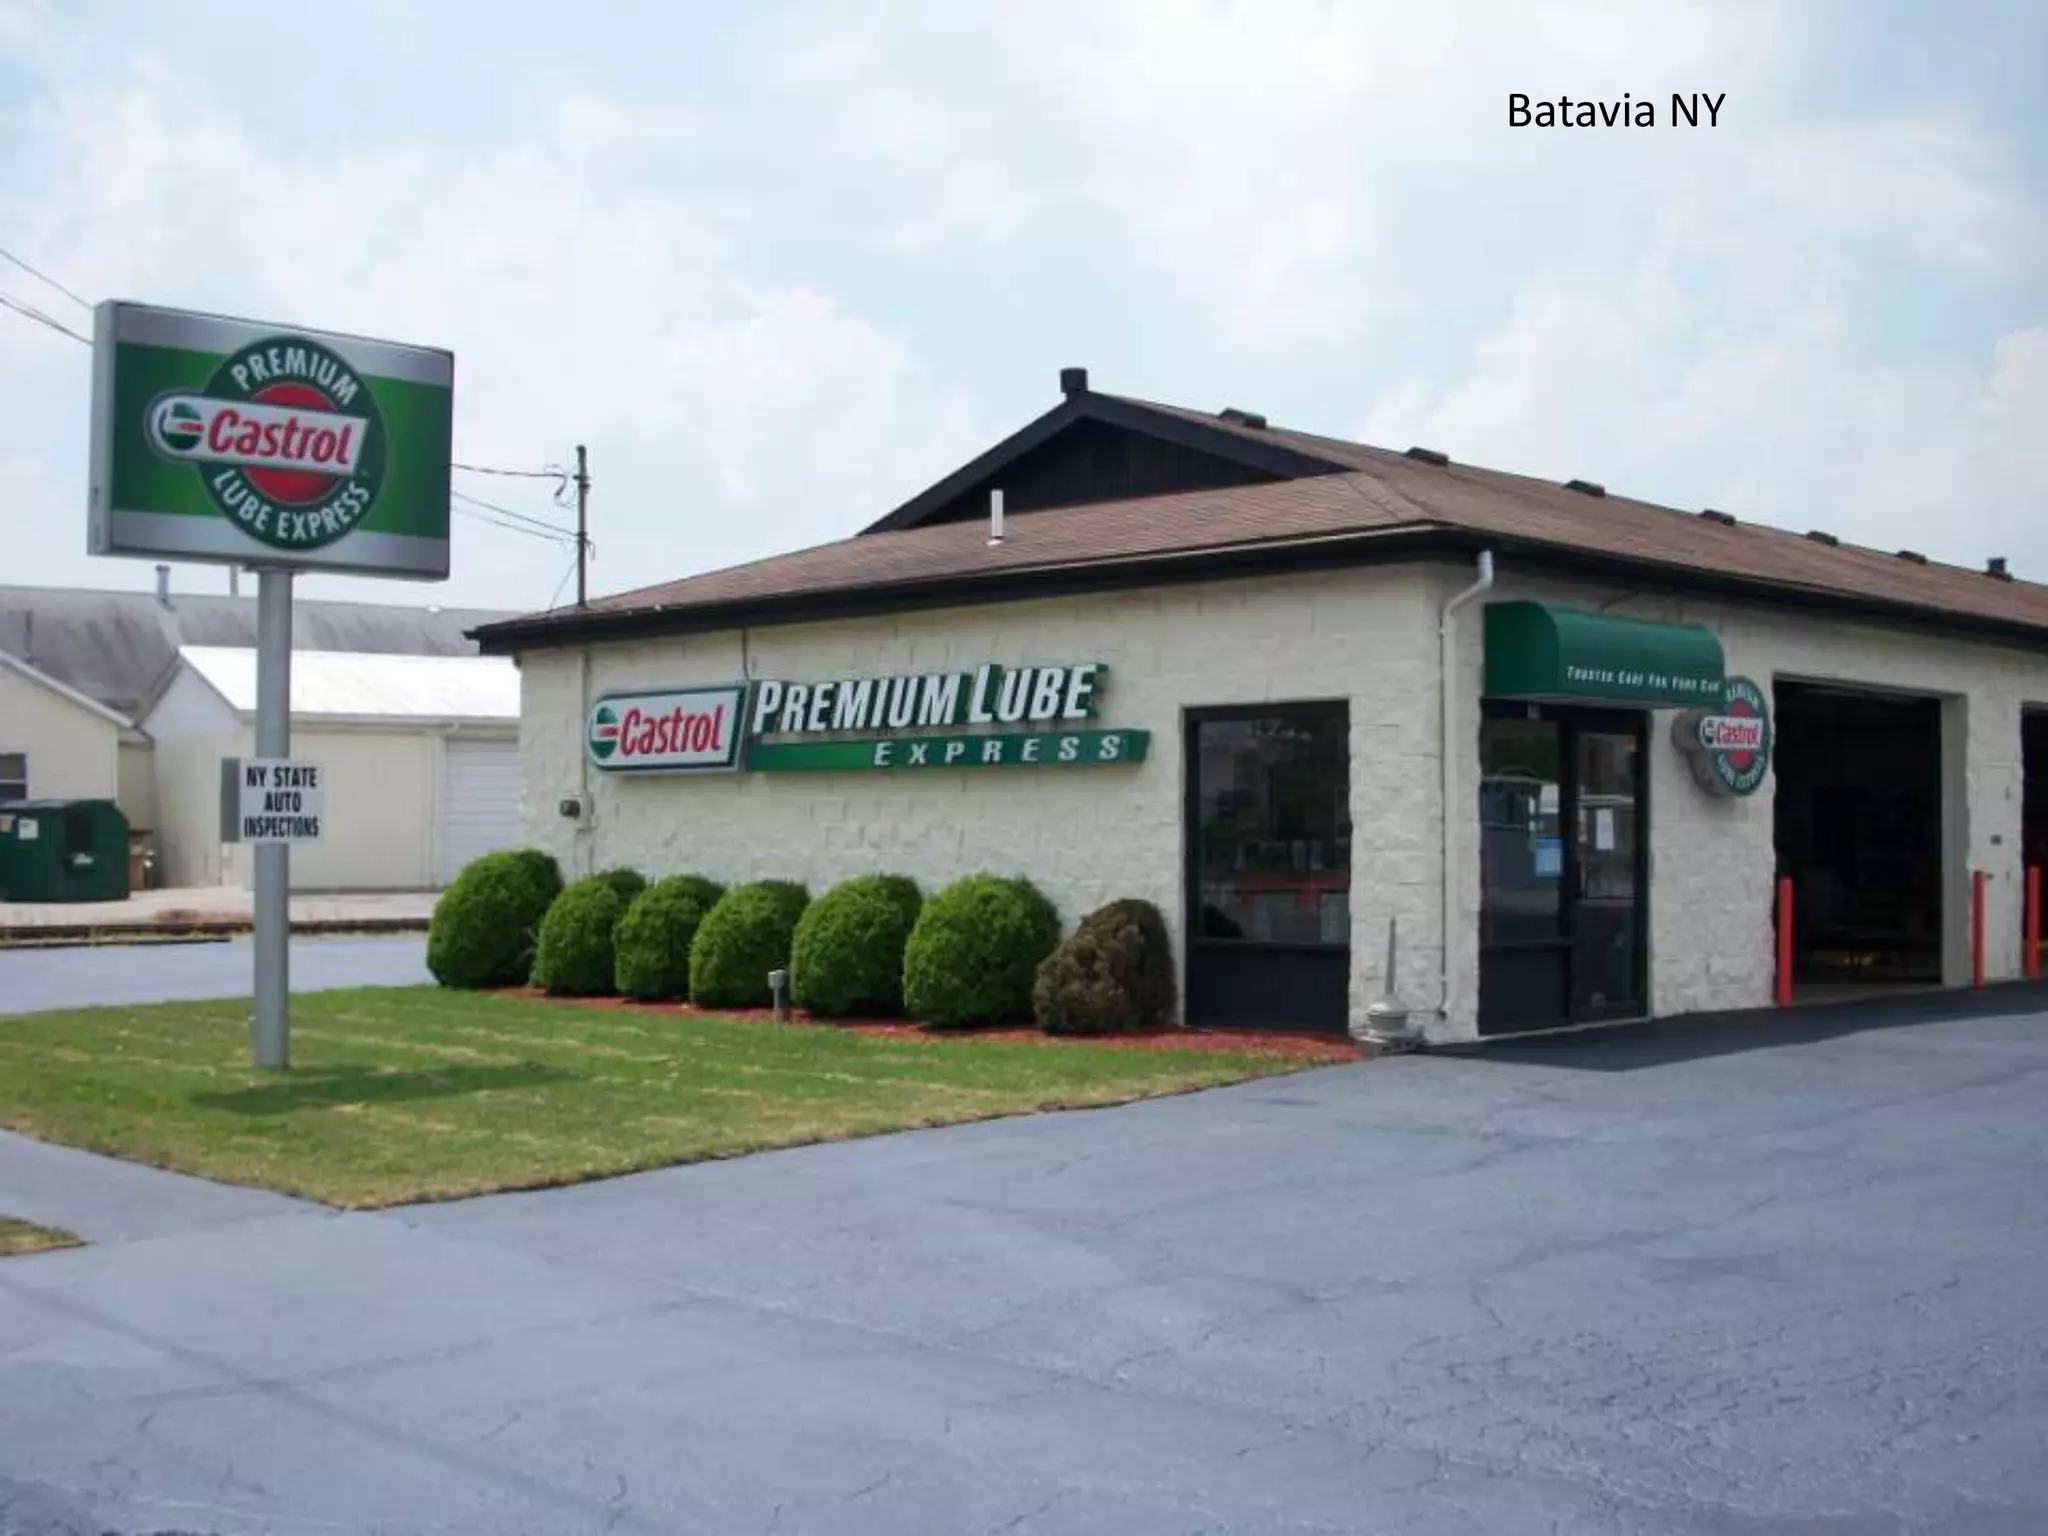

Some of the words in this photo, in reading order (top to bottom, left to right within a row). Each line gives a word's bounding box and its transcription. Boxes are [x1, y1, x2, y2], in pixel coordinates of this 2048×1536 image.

[231, 347, 360, 406] PREMIUM
[207, 409, 353, 465] Castrol
[213, 469, 272, 530] LUBE
[276, 482, 370, 541] EXPRESS
[752, 673, 962, 735] PREMIUM
[968, 663, 1098, 723] LUBE
[619, 703, 724, 757] Castrol
[873, 734, 1122, 766] EXPRESS
[246, 766, 267, 788] NY
[273, 765, 317, 788] STATE
[264, 791, 302, 813] AUTO
[243, 815, 319, 839] INSPECTIONS
